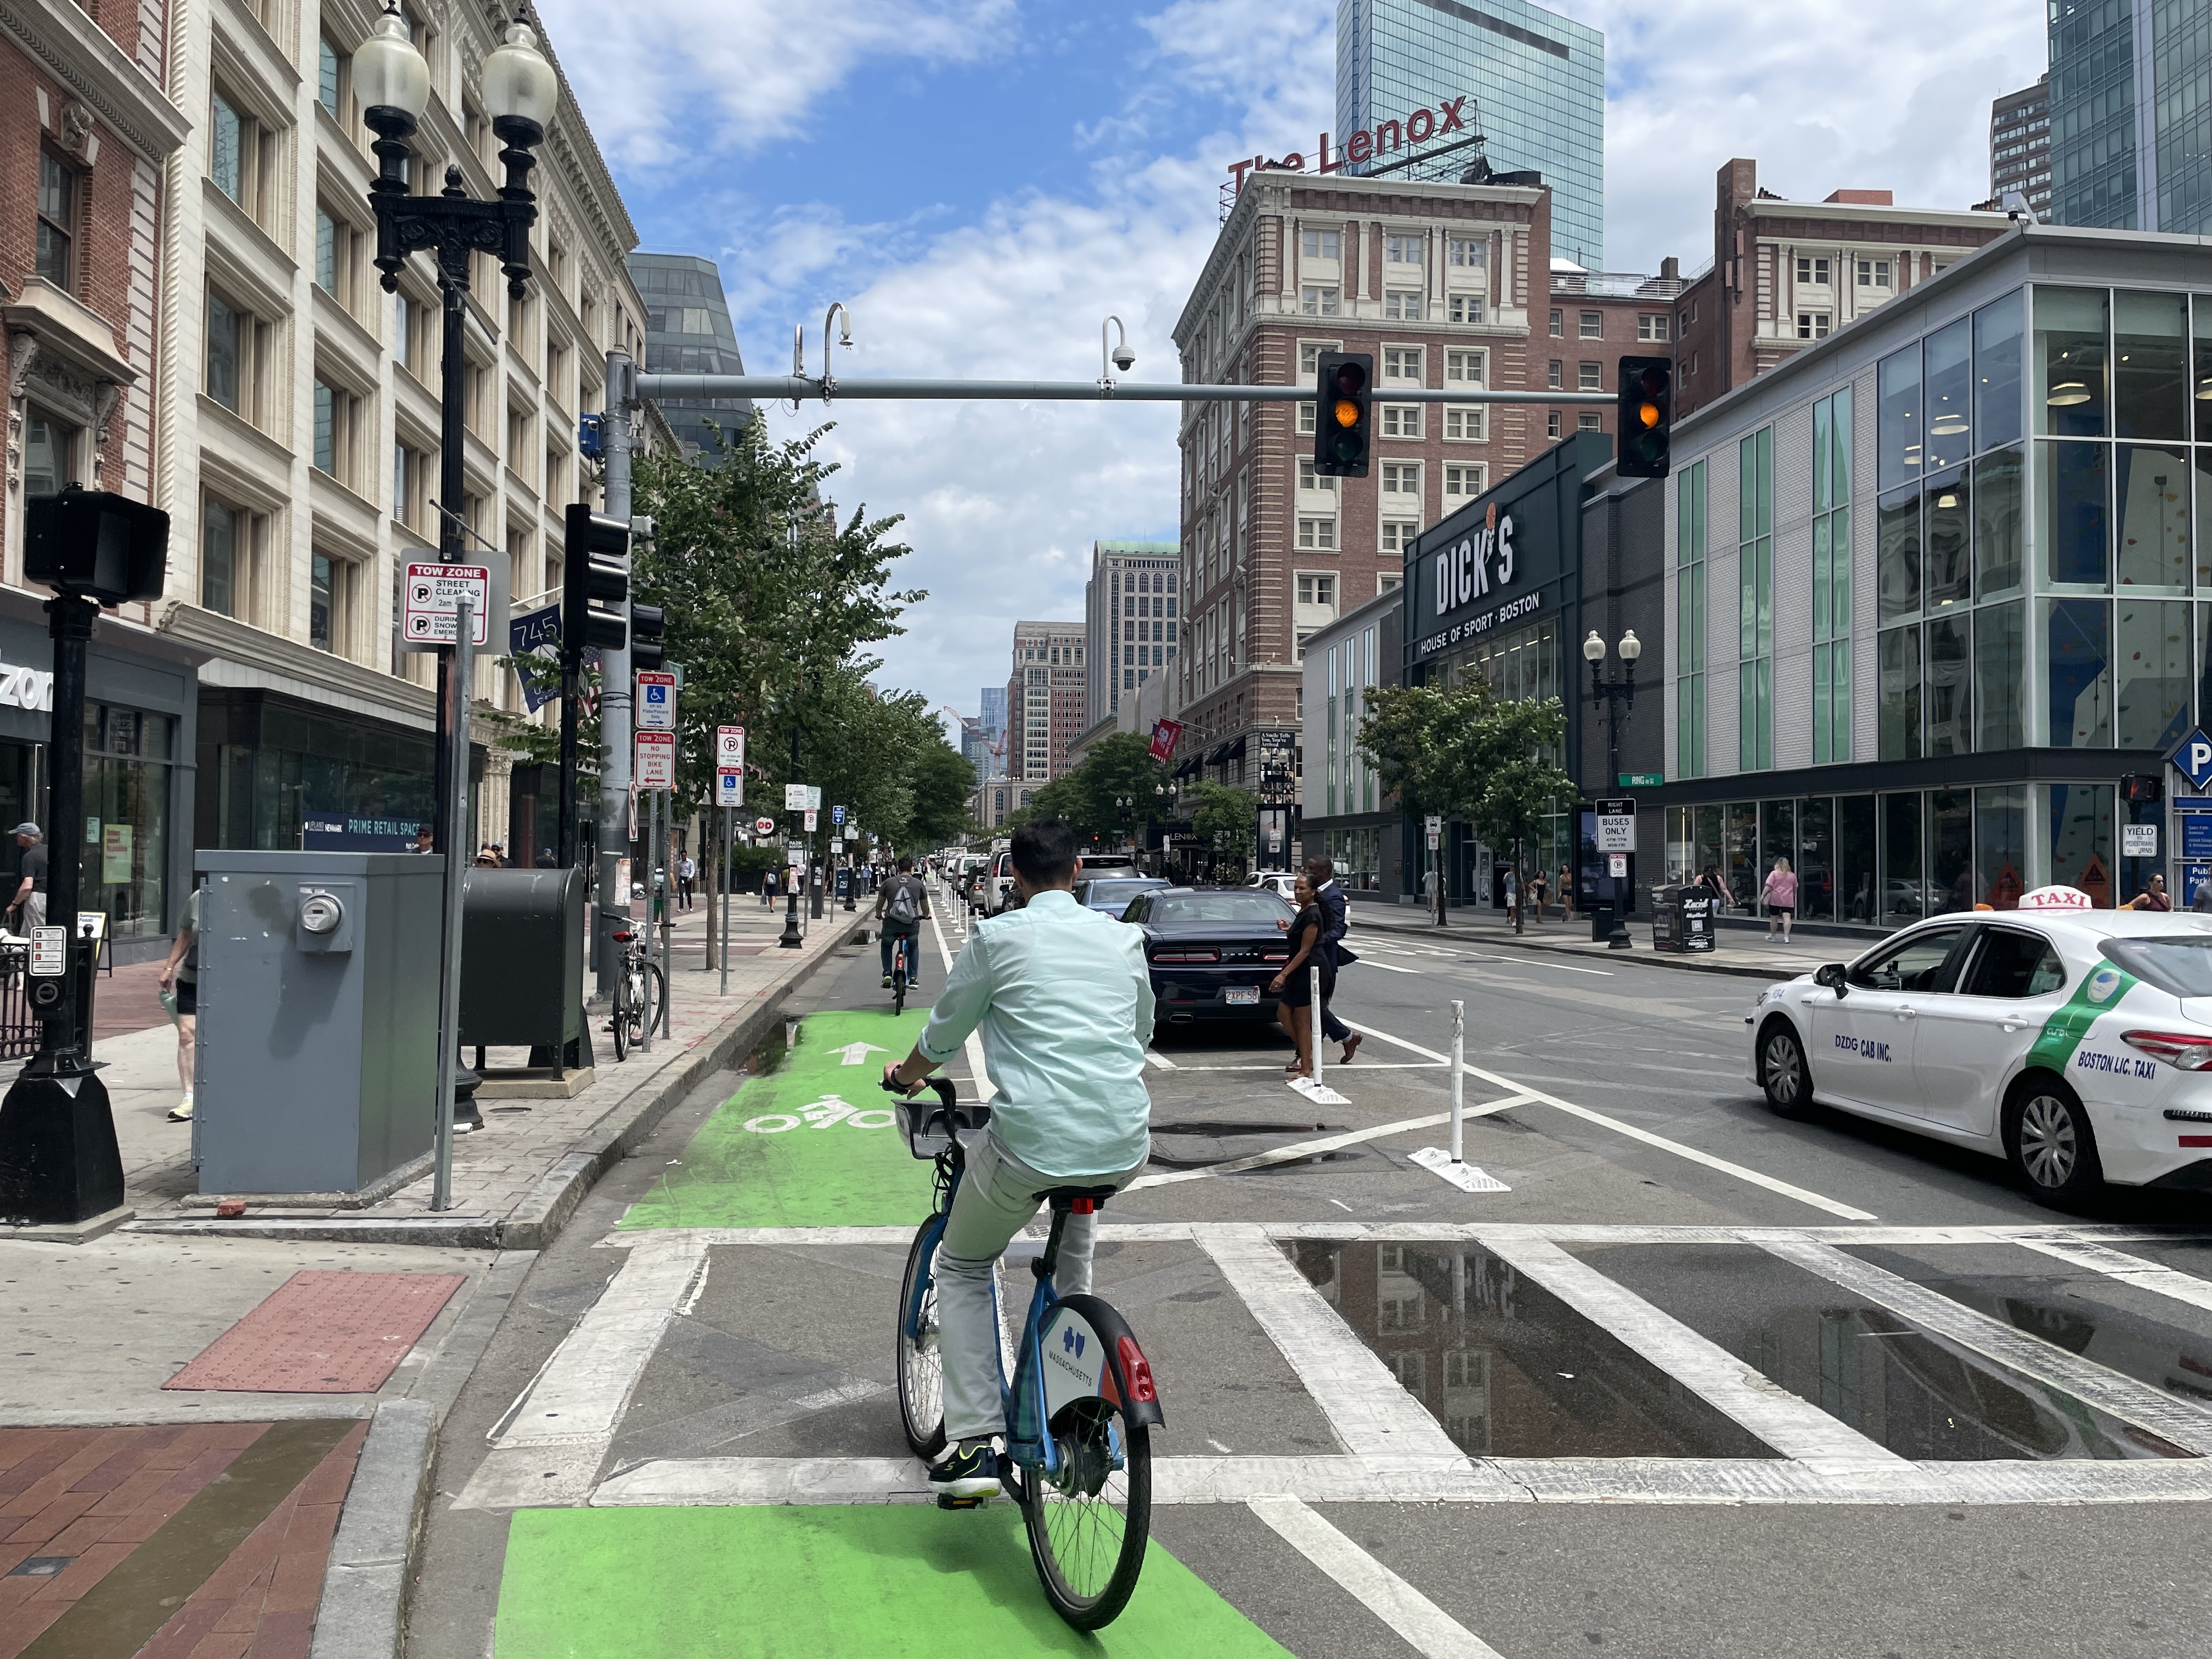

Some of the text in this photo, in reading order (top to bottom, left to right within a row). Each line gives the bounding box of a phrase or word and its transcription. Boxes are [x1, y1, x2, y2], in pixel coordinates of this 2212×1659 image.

[1319, 95, 1466, 174] Lenox
[415, 566, 481, 578] TOW ZONE
[1436, 514, 1513, 616] DICK'S
[436, 579, 470, 588] STREET
[436, 588, 480, 597] CLEANNG
[514, 615, 557, 646] 745
[1421, 592, 1539, 654] HOUSE OF SPORT BOSTON
[2191, 743, 2212, 775] P
[1632, 776, 1645, 785] RING
[348, 819, 371, 834] PRIME
[374, 820, 398, 836] RETAIL
[2031, 893, 2086, 907] TAXI
[1227, 991, 1257, 1000] 2XPF 58
[1835, 1035, 1892, 1063] DZDG CAB INC.
[2078, 1051, 2156, 1080] BOSTON LIC. TAXI
[1049, 1350, 1092, 1387] MASSACHUSETTS
